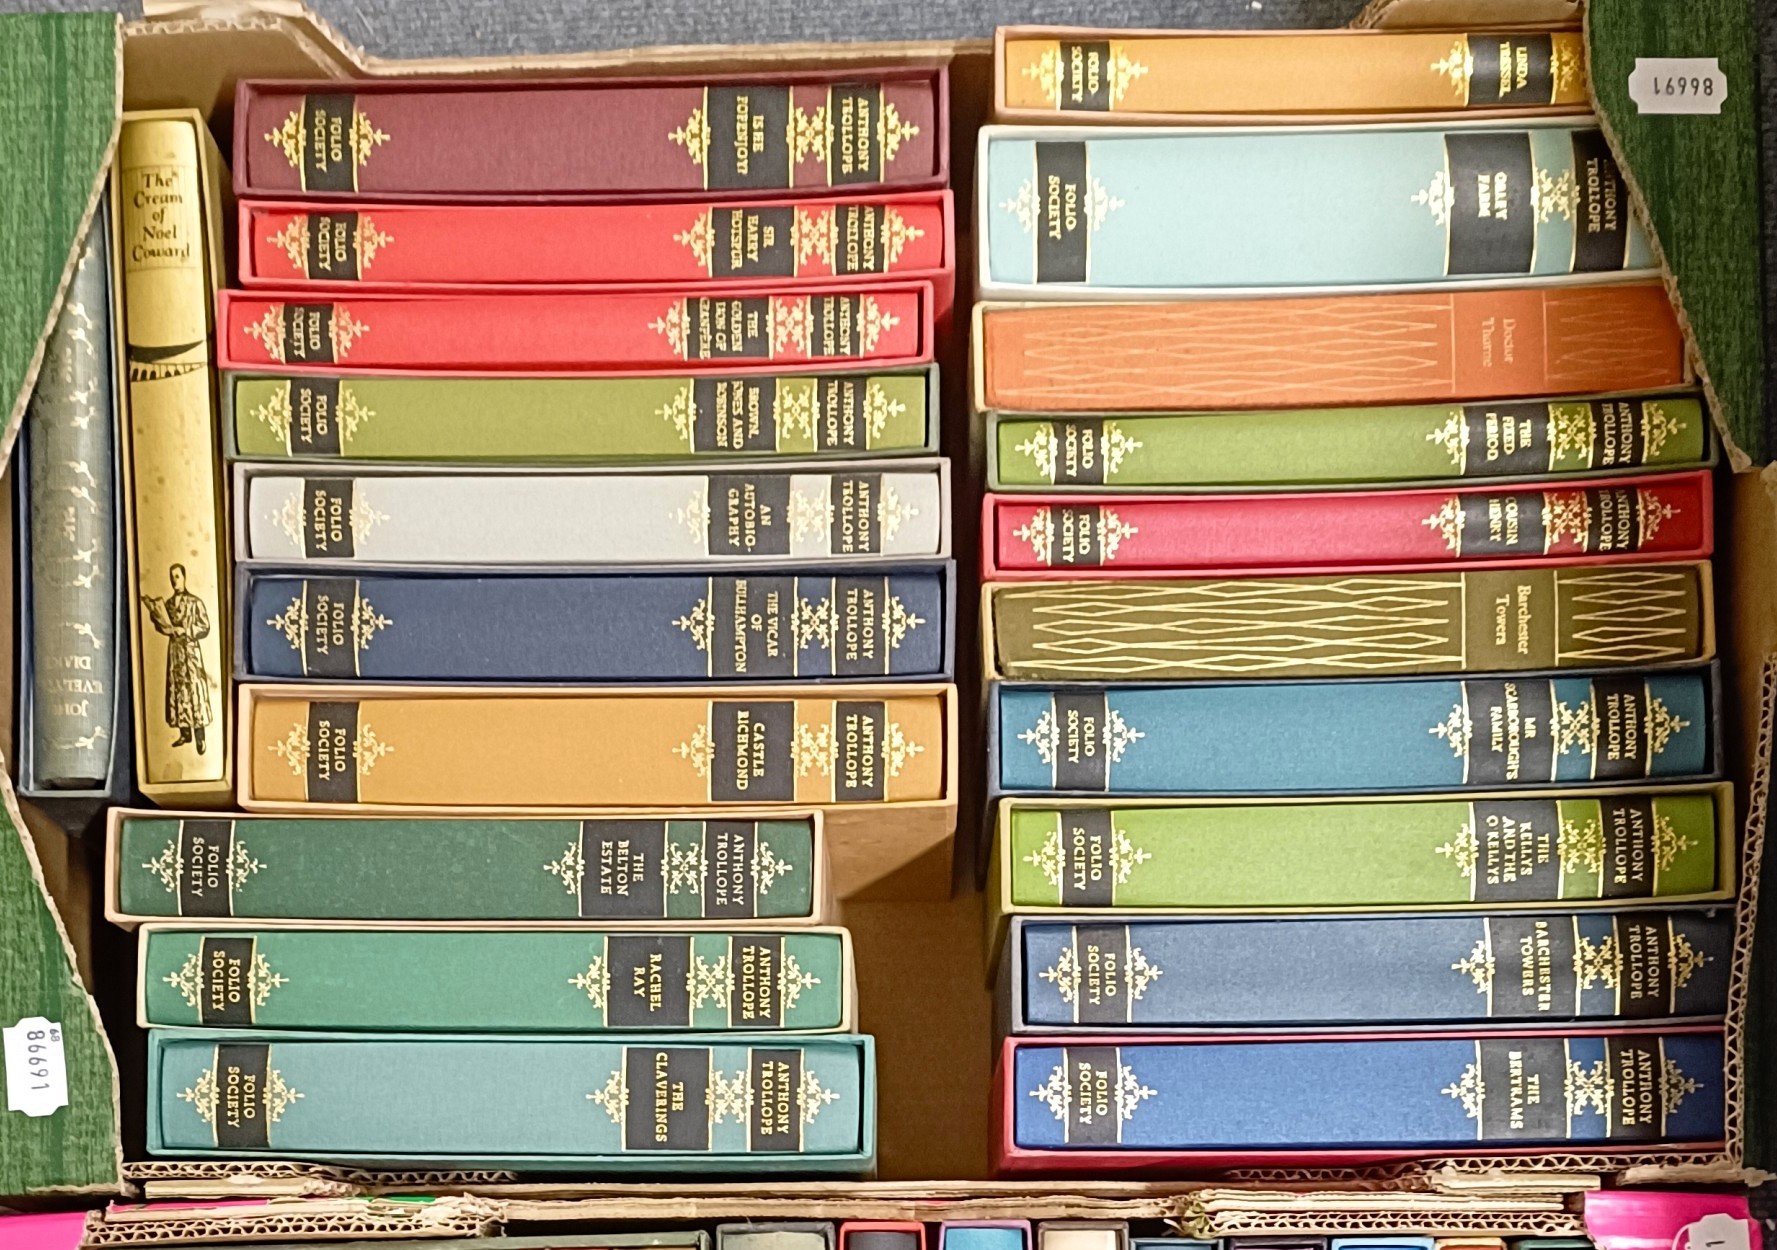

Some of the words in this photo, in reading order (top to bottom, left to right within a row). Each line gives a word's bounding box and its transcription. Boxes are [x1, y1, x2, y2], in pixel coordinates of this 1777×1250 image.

[1653, 76, 1715, 96] 86691
[134, 190, 183, 209] Cream
[142, 172, 173, 189] The
[1587, 157, 1601, 233] TROLLOPE
[143, 224, 177, 242] Noel
[152, 207, 166, 225] of
[132, 242, 190, 262] Coward
[728, 488, 740, 547] GRAPHY
[760, 504, 772, 526] AN
[842, 480, 853, 553] TROLLOPE
[858, 480, 870, 552] ANTHONY
[1495, 594, 1510, 645] Towers
[1517, 585, 1531, 655] Barchester
[736, 710, 749, 790] RICHMOND
[753, 722, 765, 777] CASTLE
[1607, 693, 1620, 760] TROLLOPE
[1623, 694, 1637, 760] ANTHONY
[1486, 815, 1499, 885] O'KELLYS
[1502, 816, 1515, 846] AND
[1520, 822, 1532, 876] KELLYS
[1537, 834, 1549, 864] THE
[191, 837, 204, 897] SOCIETY
[207, 845, 220, 889] FOLIO
[600, 841, 612, 895] ESTATE
[617, 840, 629, 896] BELTON
[632, 853, 644, 882] THE
[716, 832, 728, 906] TROLLOPE
[733, 834, 744, 906] ANTHONY
[1503, 849, 1516, 882] THE
[633, 966, 646, 998] RAY
[650, 953, 662, 1012] RACHEL
[1520, 936, 1533, 997] TOWERS
[1535, 921, 1551, 1012] BARCHESTER
[1628, 925, 1643, 1000] TROLLOPE
[1645, 926, 1659, 998] ANTHONY
[27, 1030, 50, 1090] 86691
[227, 1066, 240, 1129] SOCIETY
[243, 1074, 256, 1120] FOLIO
[655, 1052, 668, 1143] CLAVERINGS
[672, 1082, 683, 1111] THE
[1508, 1050, 1524, 1130] BERTRAMS
[1527, 1074, 1540, 1105] THE
